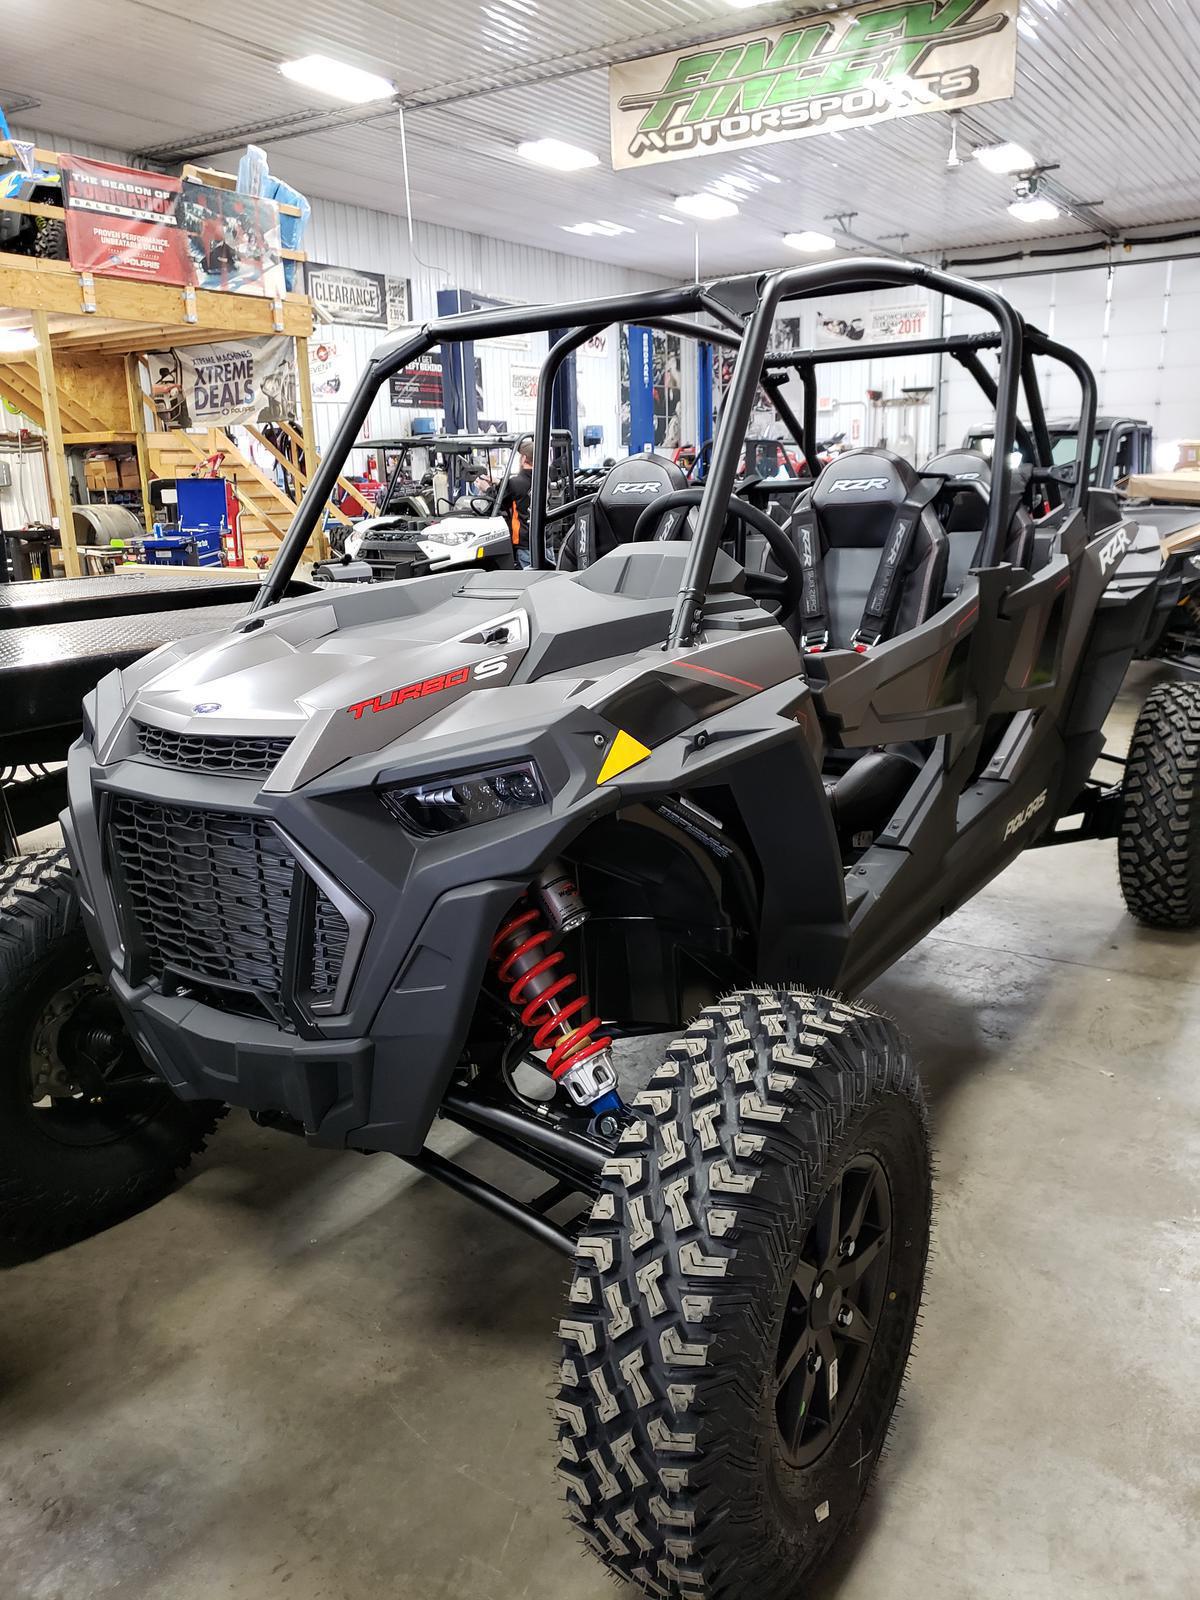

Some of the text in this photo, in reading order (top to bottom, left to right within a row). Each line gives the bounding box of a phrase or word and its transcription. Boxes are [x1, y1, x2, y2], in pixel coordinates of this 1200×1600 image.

[622, 0, 1004, 132] FINLEY
[72, 173, 170, 200] THE SEASON OF
[315, 281, 376, 307] CLEARANCE
[898, 319, 922, 334] 2011
[216, 350, 253, 363] MACHINES
[194, 359, 254, 386] XTREME
[194, 379, 255, 410] DEALS
[230, 406, 256, 414] POLARIS
[611, 482, 662, 495] RZR
[828, 477, 890, 494] RZR
[800, 528, 812, 568] RZR
[887, 522, 906, 566] RZR
[1099, 527, 1132, 577] RZR
[346, 654, 509, 720] TURBO S
[1003, 788, 1048, 842] POLARIS
